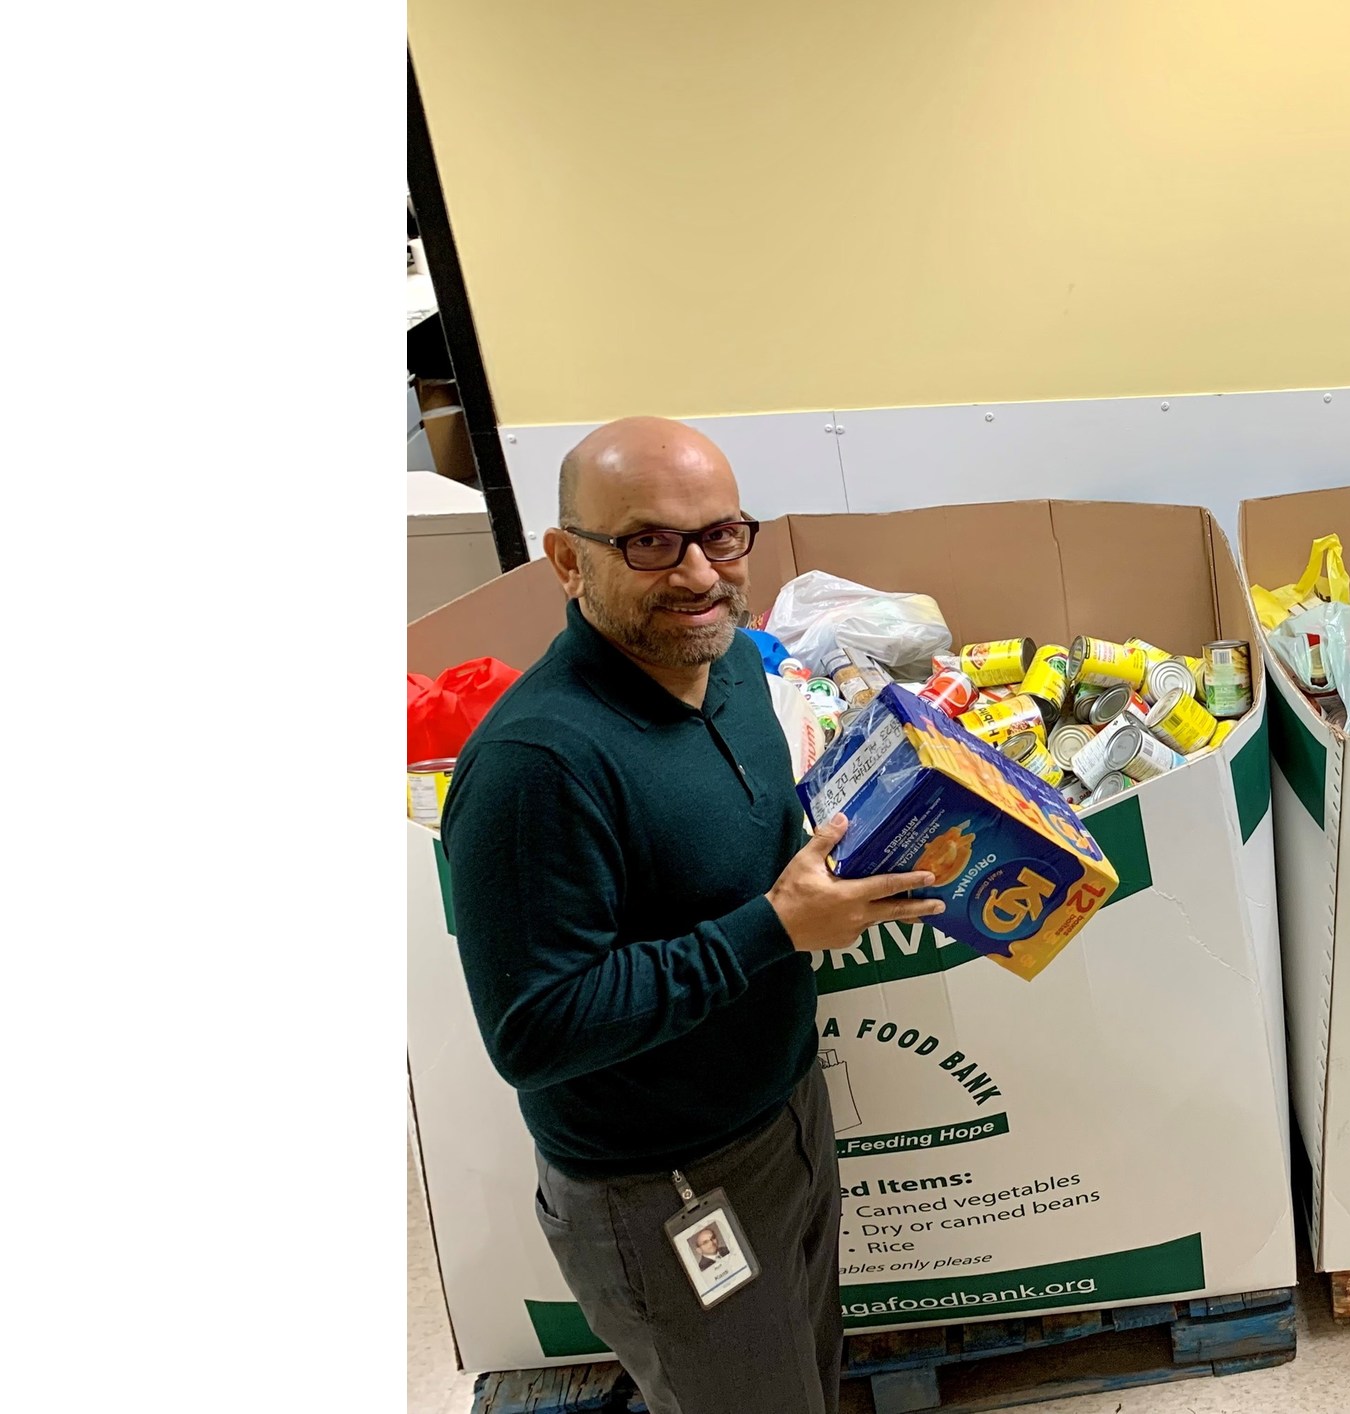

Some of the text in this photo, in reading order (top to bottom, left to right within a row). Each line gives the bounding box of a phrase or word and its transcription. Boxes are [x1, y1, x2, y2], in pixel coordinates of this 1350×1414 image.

[884, 815, 919, 854] ARTIFICIELS
[898, 822, 940, 867] NO ARTIFICIAL
[901, 829, 919, 849] SANS
[952, 853, 997, 900] ORIGINAL
[982, 866, 1057, 934] KD
[1066, 883, 1106, 914] 12
[1063, 914, 1085, 936] boxes
[856, 1018, 940, 1056] FOOD
[938, 1050, 1002, 1106] BANK
[939, 1121, 995, 1142] Hope
[855, 1173, 1081, 1218] Canned vegetables
[878, 1171, 974, 1196] Items:
[861, 1189, 1101, 1238] Dry or canned beans
[867, 1240, 915, 1254] Rice
[889, 1259, 930, 1272] only
[933, 1253, 993, 1270] please
